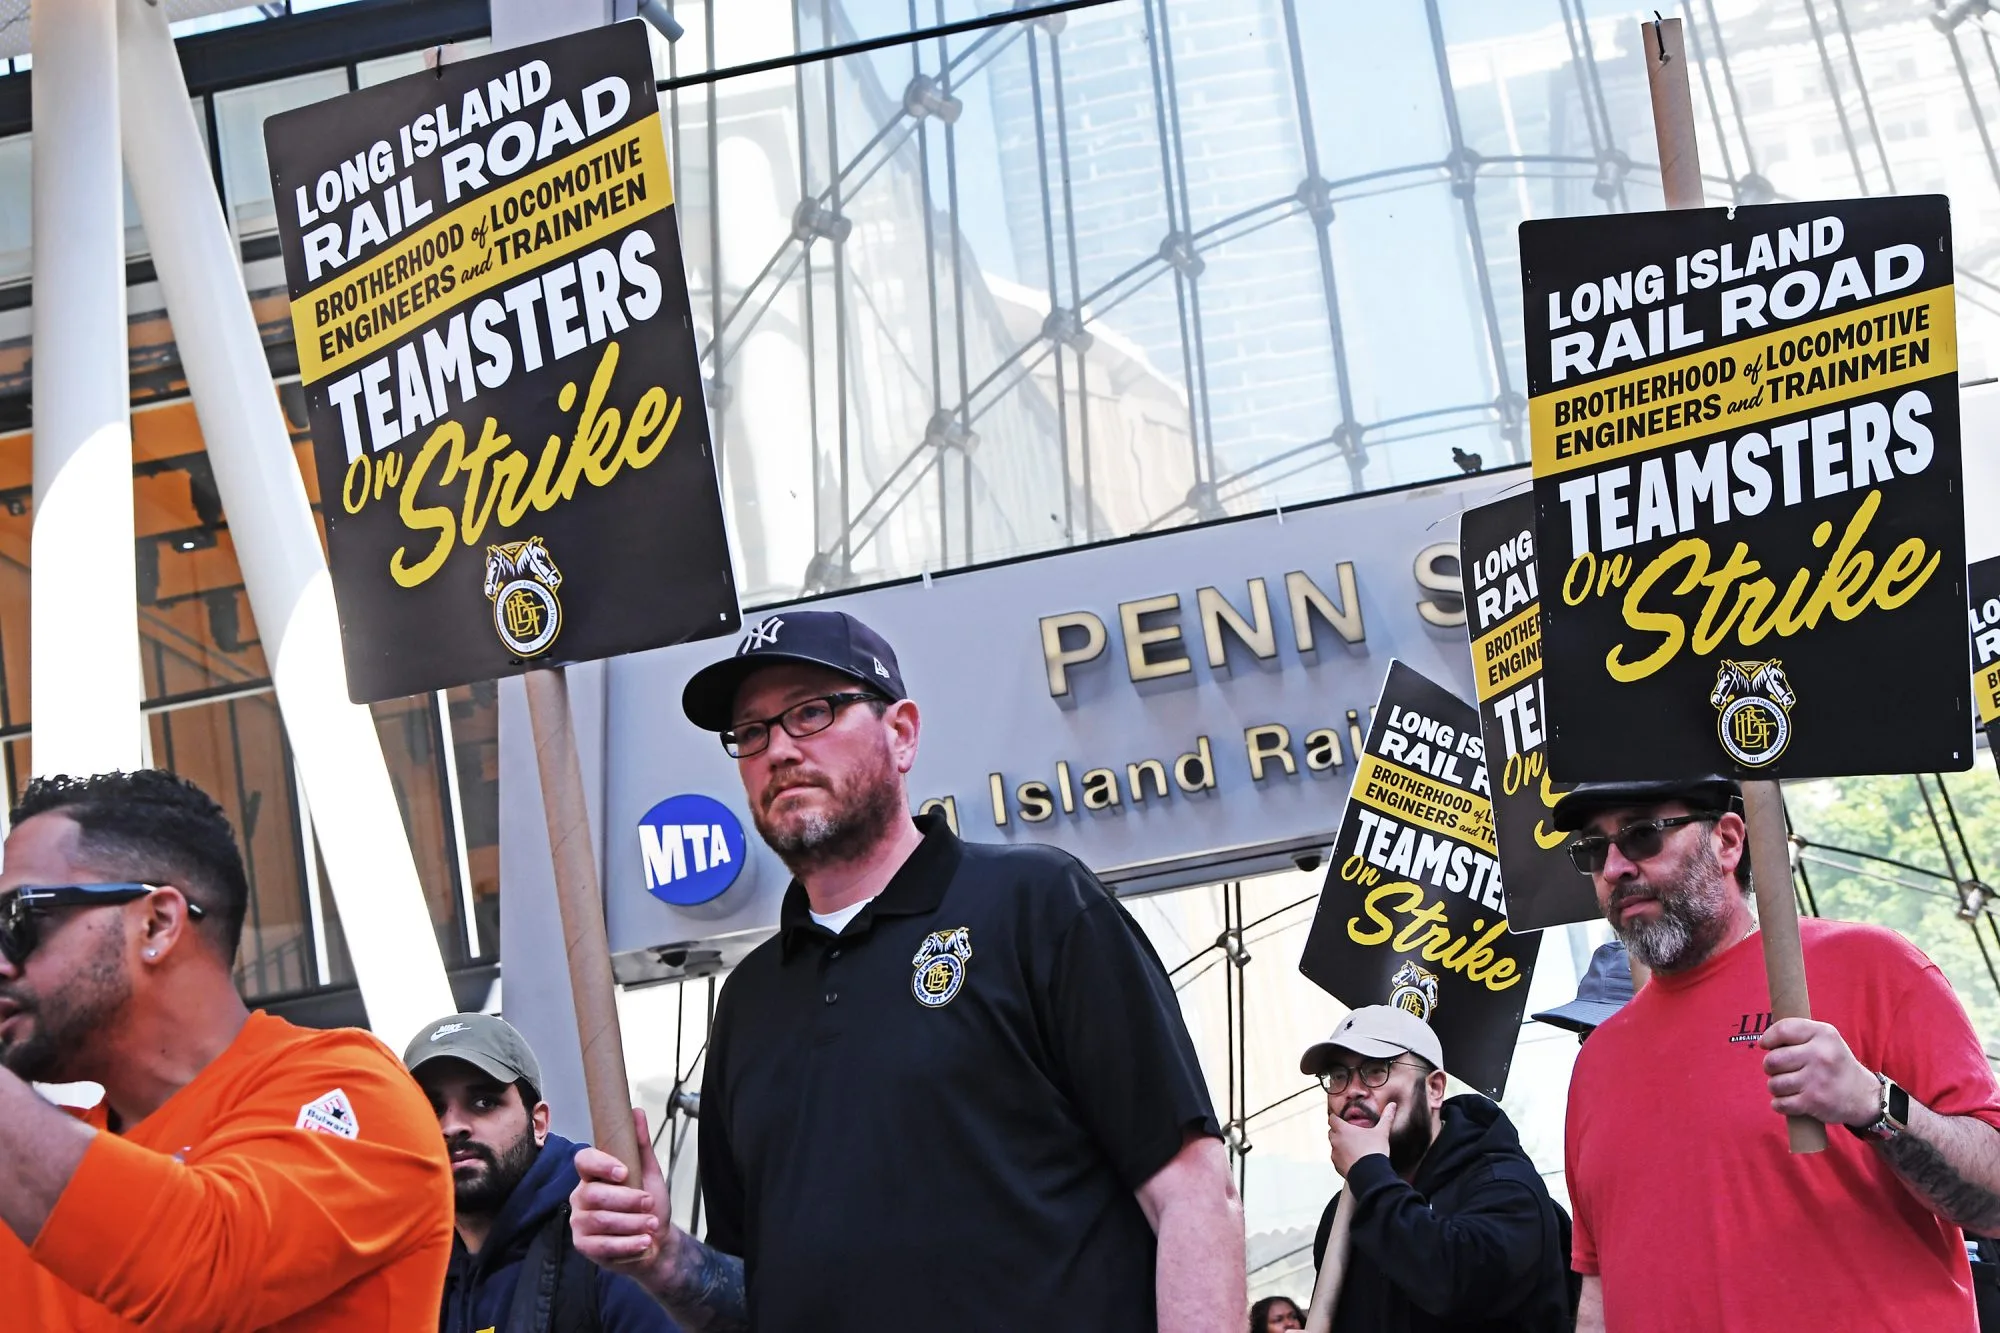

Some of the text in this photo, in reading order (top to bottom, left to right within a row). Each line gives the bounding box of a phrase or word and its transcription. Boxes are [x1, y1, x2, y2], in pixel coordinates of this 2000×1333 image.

[295, 59, 552, 227] LONG ISLAND
[302, 75, 631, 282] RAIL ROAD
[315, 137, 642, 328] BROTHERHOOD of LOCOMOTIVE
[319, 173, 647, 362] ENGINEERS and TRAINMEN
[1549, 215, 1844, 331] LONG ISLAND
[328, 229, 663, 464] TEAMSTERS
[1551, 243, 1925, 384] RAIL ROAD
[1554, 304, 1930, 427] BROTHERHOOD of LOCOMOTIVE
[1555, 337, 1930, 460] ENGINEERS and TRAINMEN
[343, 341, 681, 588] On Strike
[1559, 389, 1935, 560] TEAMSTERS
[1473, 530, 1534, 591] LONG
[1477, 559, 1540, 630] RAI
[1563, 551, 1632, 607] On
[1605, 489, 1941, 683] Strike
[1969, 596, 2000, 634] LO
[1038, 561, 1365, 698] PENN
[988, 734, 1218, 826] Island
[1244, 706, 1376, 782] Rai
[1378, 729, 1463, 785] RAIL
[1388, 705, 1455, 748] LONG
[1503, 752, 1544, 796] On
[1365, 783, 1459, 829] ENGINEERS
[1459, 822, 1480, 837] and
[1371, 764, 1473, 814] BROTHERHOOD
[1473, 808, 1485, 823] of
[638, 824, 731, 890] MTA
[1352, 809, 1506, 915] TEAMSTE
[1340, 855, 1521, 991] On Strike
[307, 1108, 350, 1136] Bulwark
